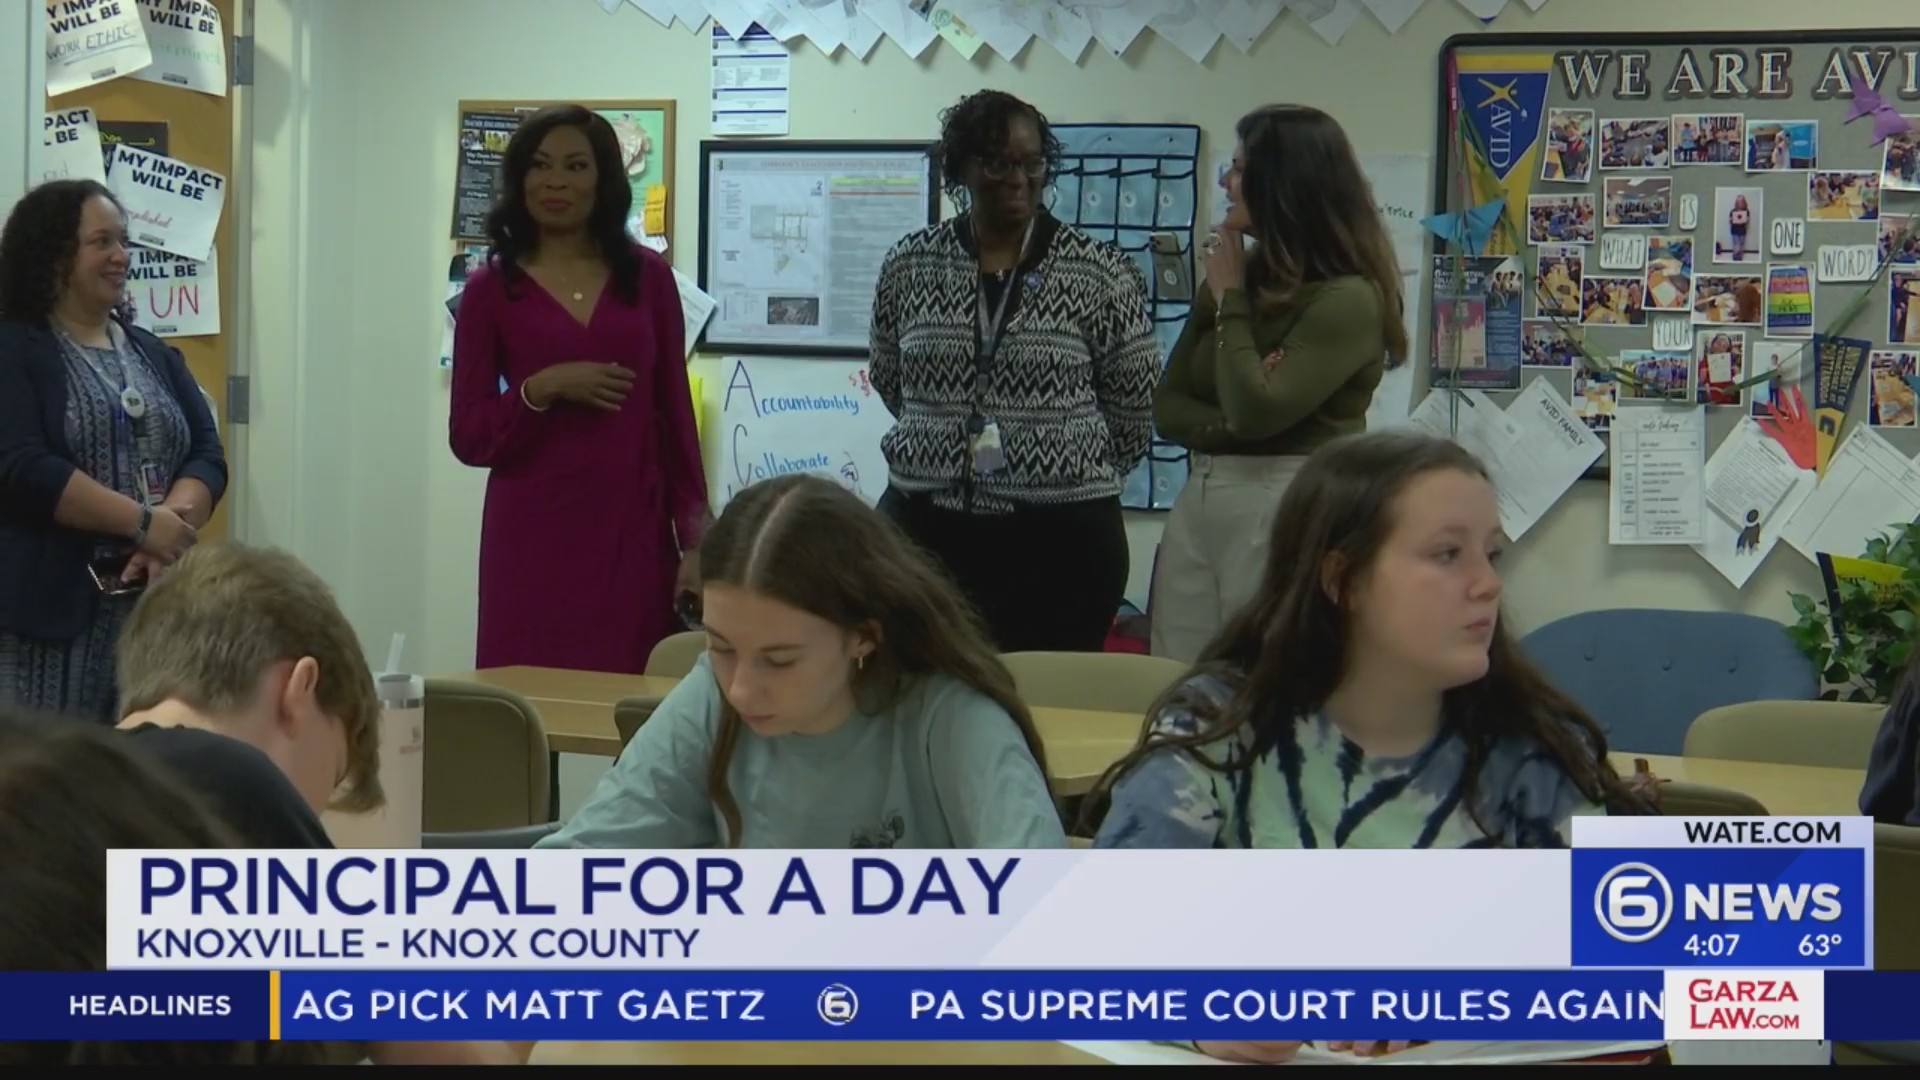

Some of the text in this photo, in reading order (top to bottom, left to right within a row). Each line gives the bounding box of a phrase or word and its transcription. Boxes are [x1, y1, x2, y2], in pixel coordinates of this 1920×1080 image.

[50, 3, 121, 33] WILL BE
[150, 10, 214, 35] WILL BE
[46, 24, 131, 60] WORK ETHIC
[1560, 51, 1920, 95] WE ARE AVI
[45, 109, 90, 130] PACT
[56, 128, 79, 144] BE
[1490, 103, 1512, 169] AVID
[118, 150, 223, 190] MY IMPACT
[132, 170, 205, 200] WILL BE
[1682, 197, 1698, 226] IS
[1774, 222, 1802, 249] ONE
[139, 250, 189, 264] IMPA
[1603, 238, 1642, 266] WHAT
[1823, 251, 1874, 277] WORD?
[127, 264, 198, 280] WILL BE
[1655, 319, 1691, 345] YOUR
[724, 359, 860, 418] Accountability
[1540, 398, 1586, 446] AVID FAMILY
[733, 423, 830, 487] Collaborate
